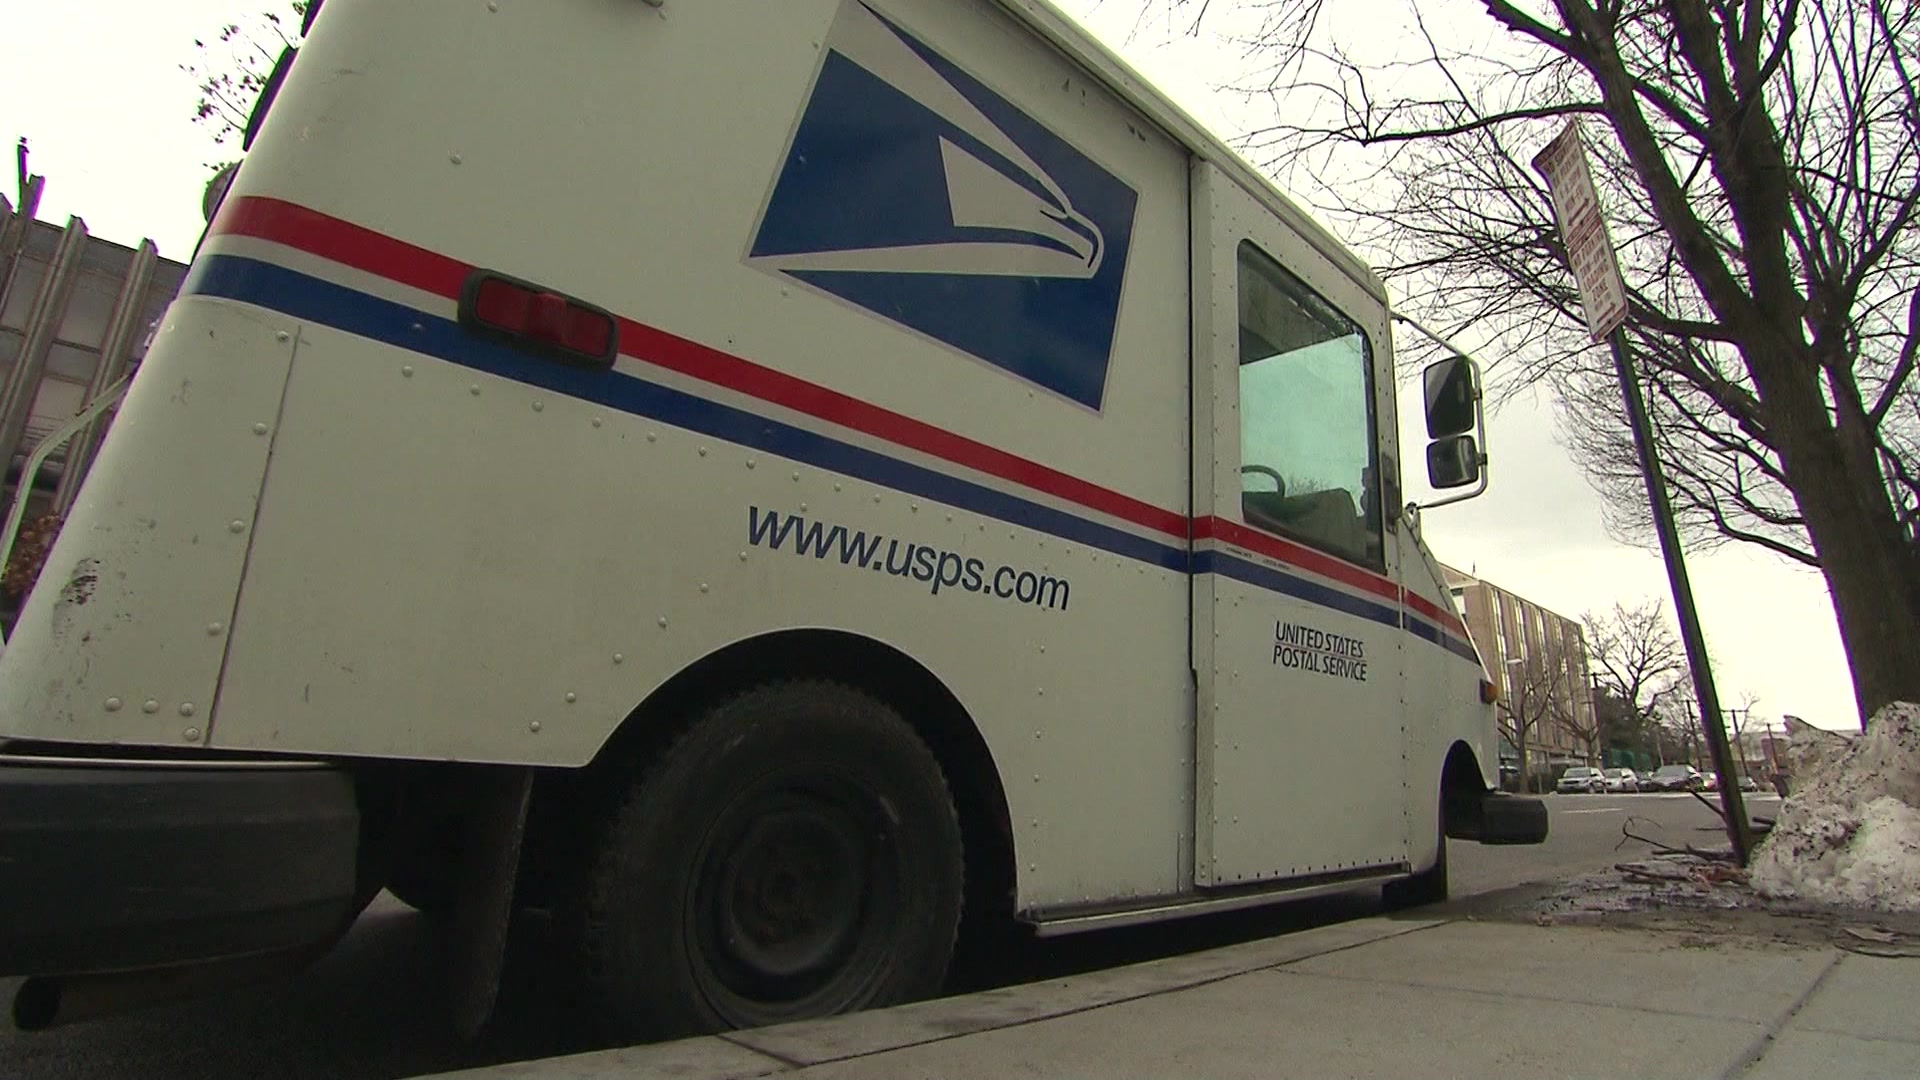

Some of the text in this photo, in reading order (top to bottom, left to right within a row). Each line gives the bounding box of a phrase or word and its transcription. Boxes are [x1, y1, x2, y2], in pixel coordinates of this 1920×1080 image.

[1573, 228, 1604, 268] NO PARKING
[1583, 259, 1609, 293] LOADING
[1592, 279, 1608, 302] ZONE
[750, 505, 1070, 610] www.usps.com
[1276, 620, 1364, 658] UNITED STATES
[1273, 645, 1367, 682] POSTAL SERVICE
